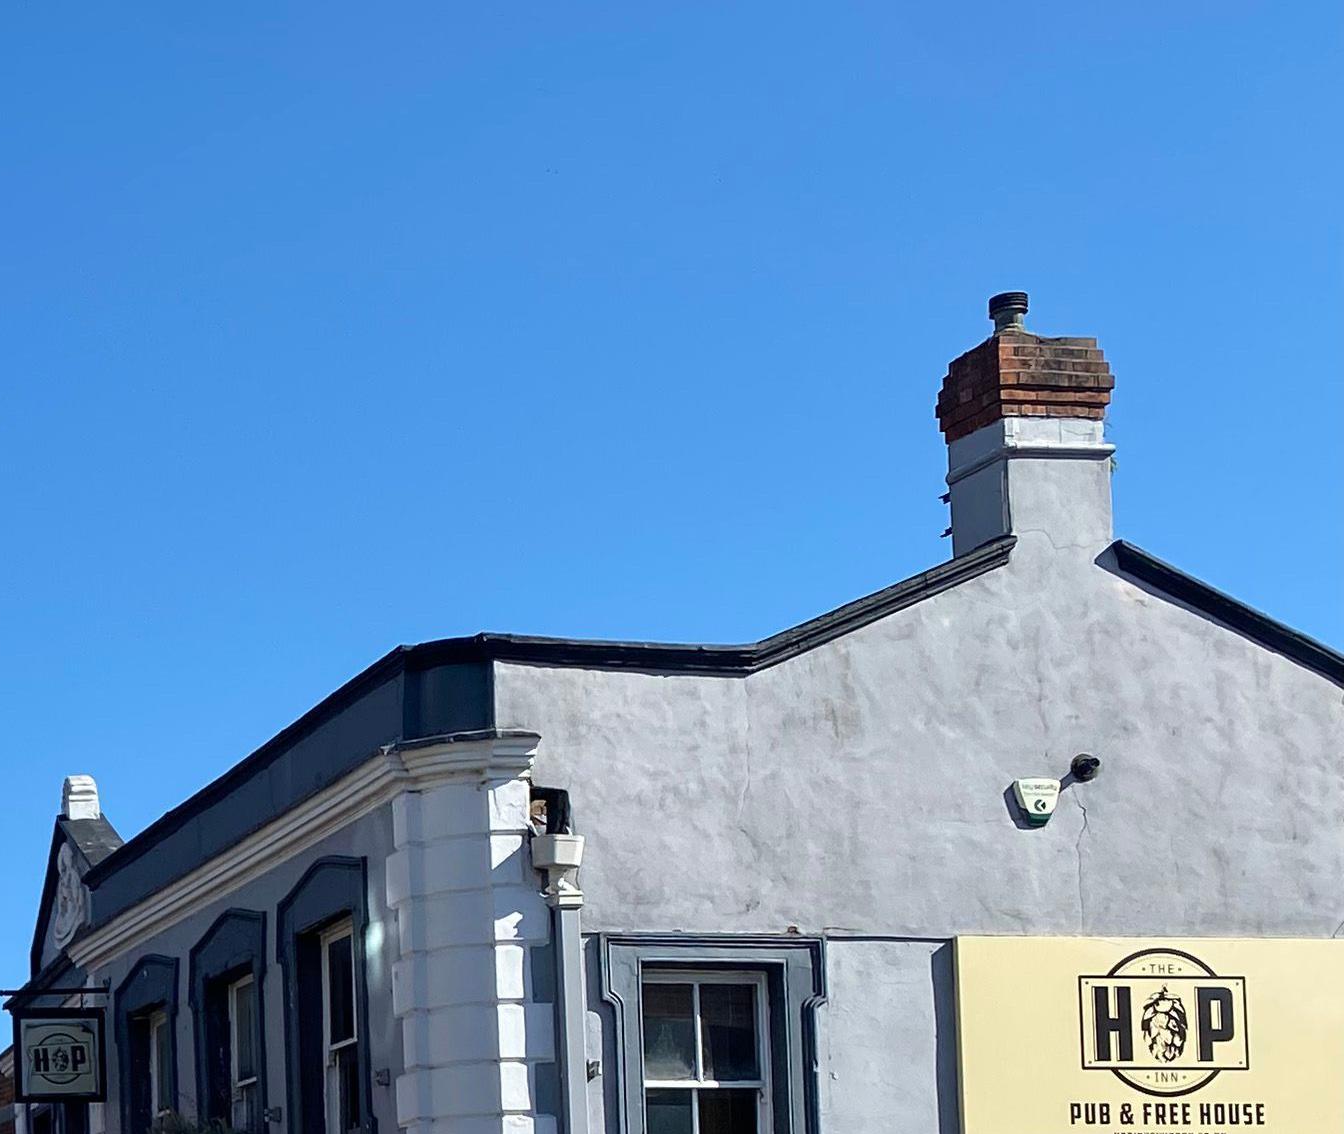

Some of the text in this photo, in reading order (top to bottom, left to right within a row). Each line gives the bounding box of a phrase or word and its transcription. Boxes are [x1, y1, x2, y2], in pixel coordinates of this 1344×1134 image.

[1150, 964, 1175, 974] THE
[1091, 985, 1235, 1062] HOP
[33, 1045, 86, 1072] HOP
[1155, 1072, 1179, 1082] INN
[1070, 1103, 1266, 1125] PUB & FREE HOUSE
